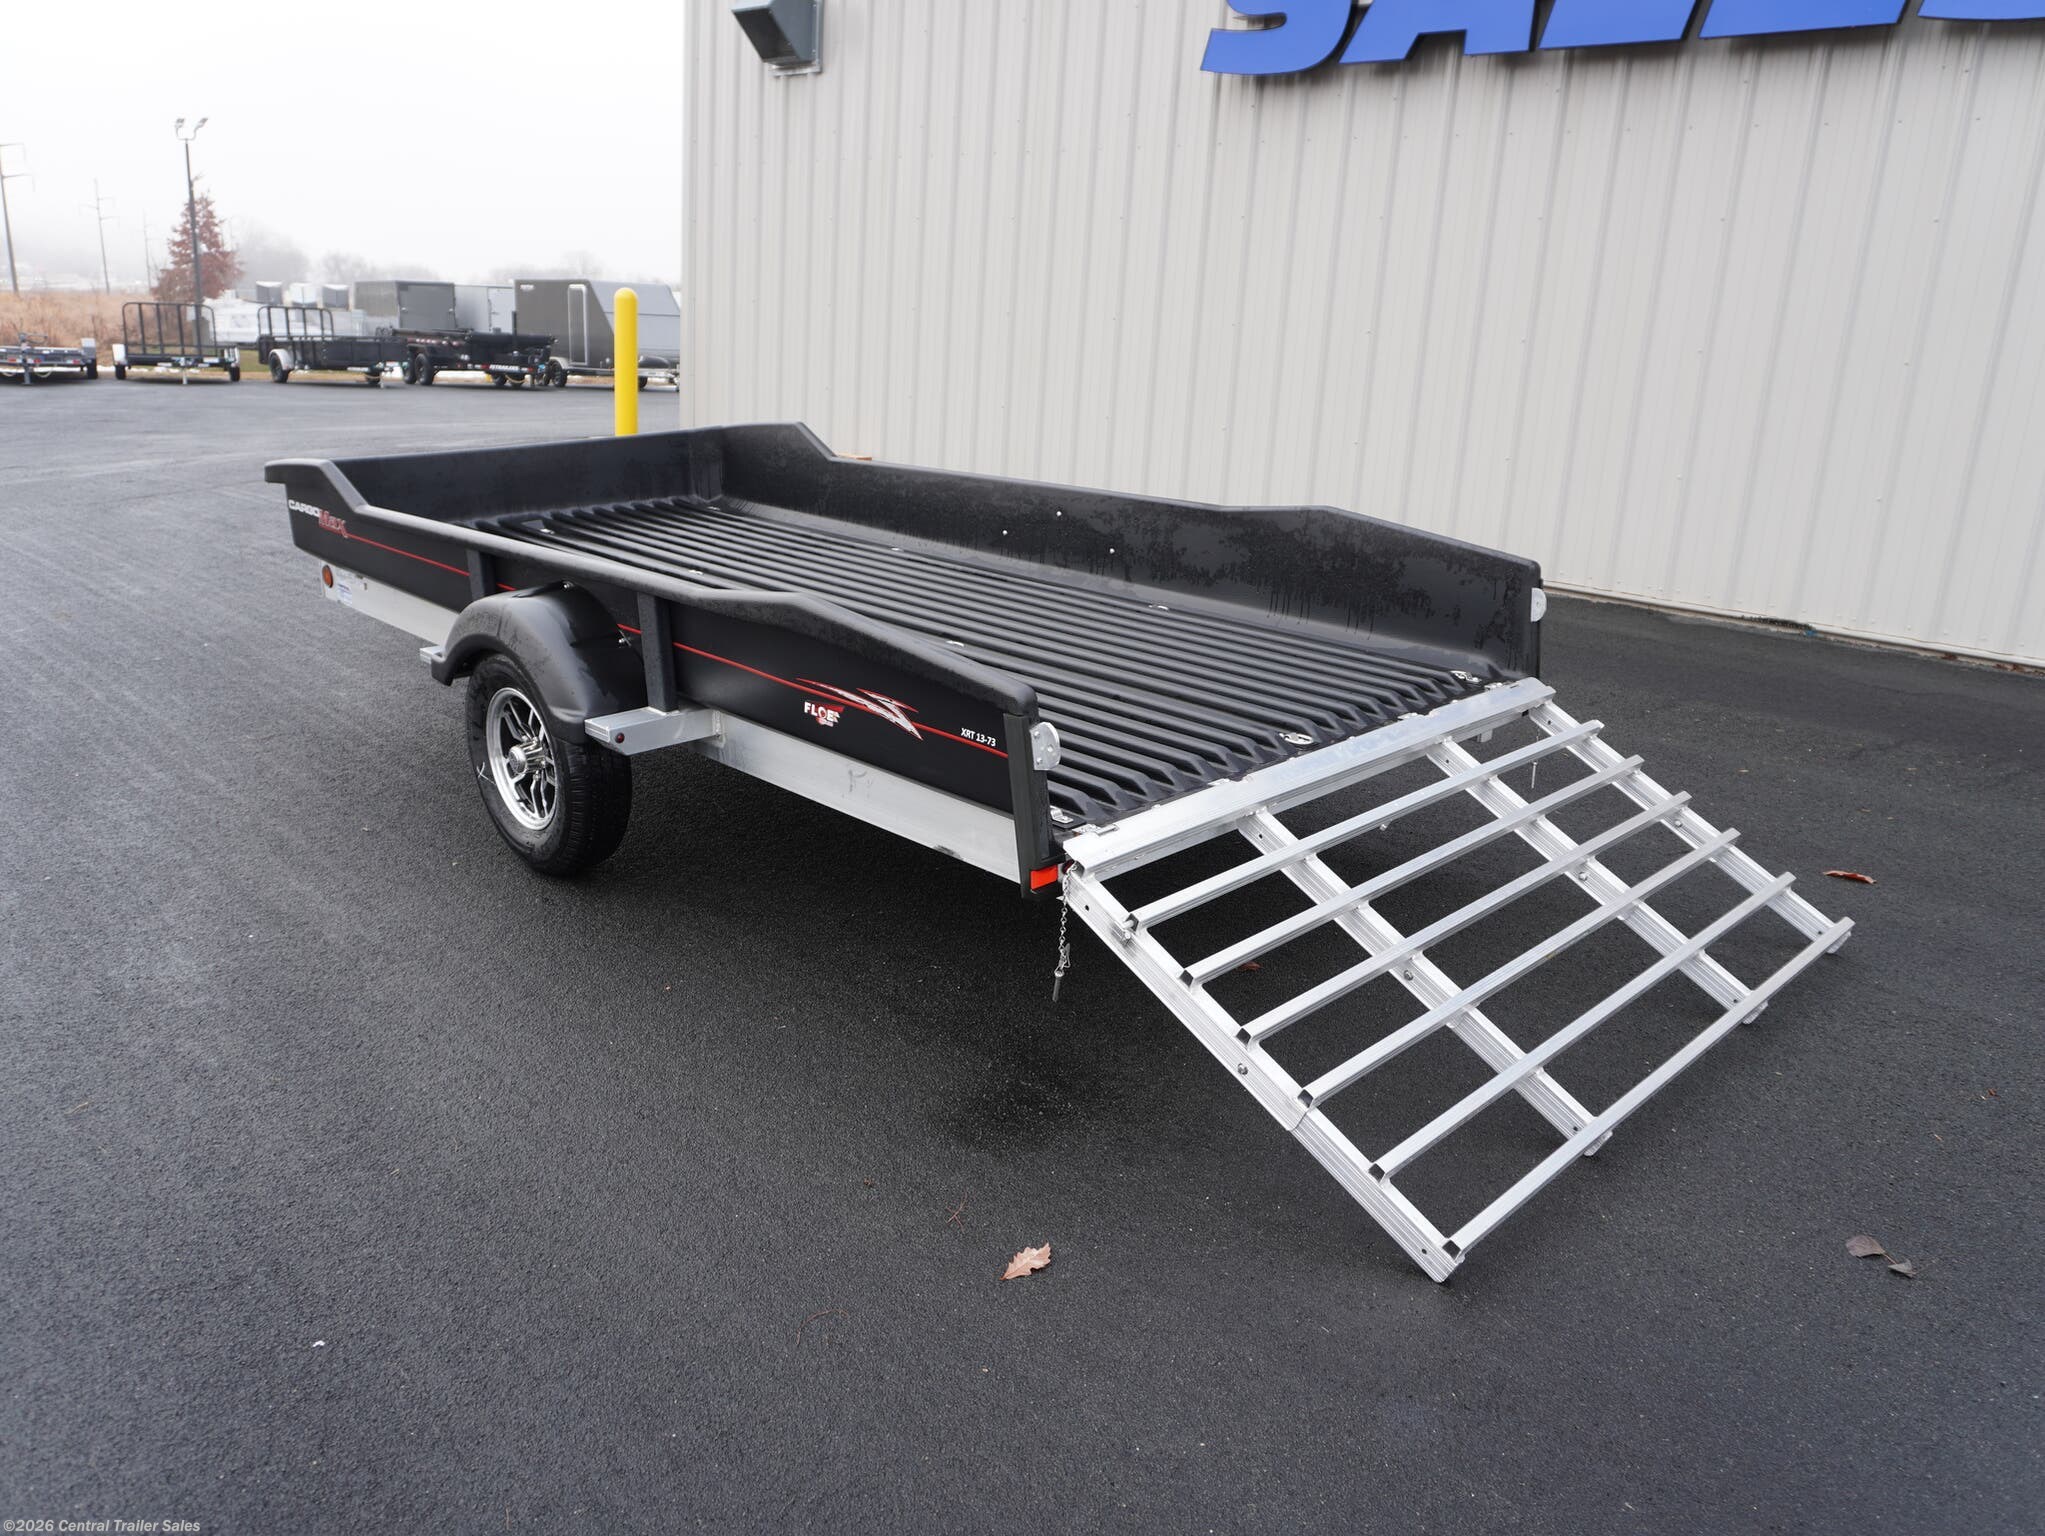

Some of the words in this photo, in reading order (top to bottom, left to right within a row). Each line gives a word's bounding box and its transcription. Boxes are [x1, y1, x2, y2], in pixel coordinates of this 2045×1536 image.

[804, 701, 840, 723] FLOE
[961, 727, 976, 740] XRT
[976, 732, 996, 747] 13-73
